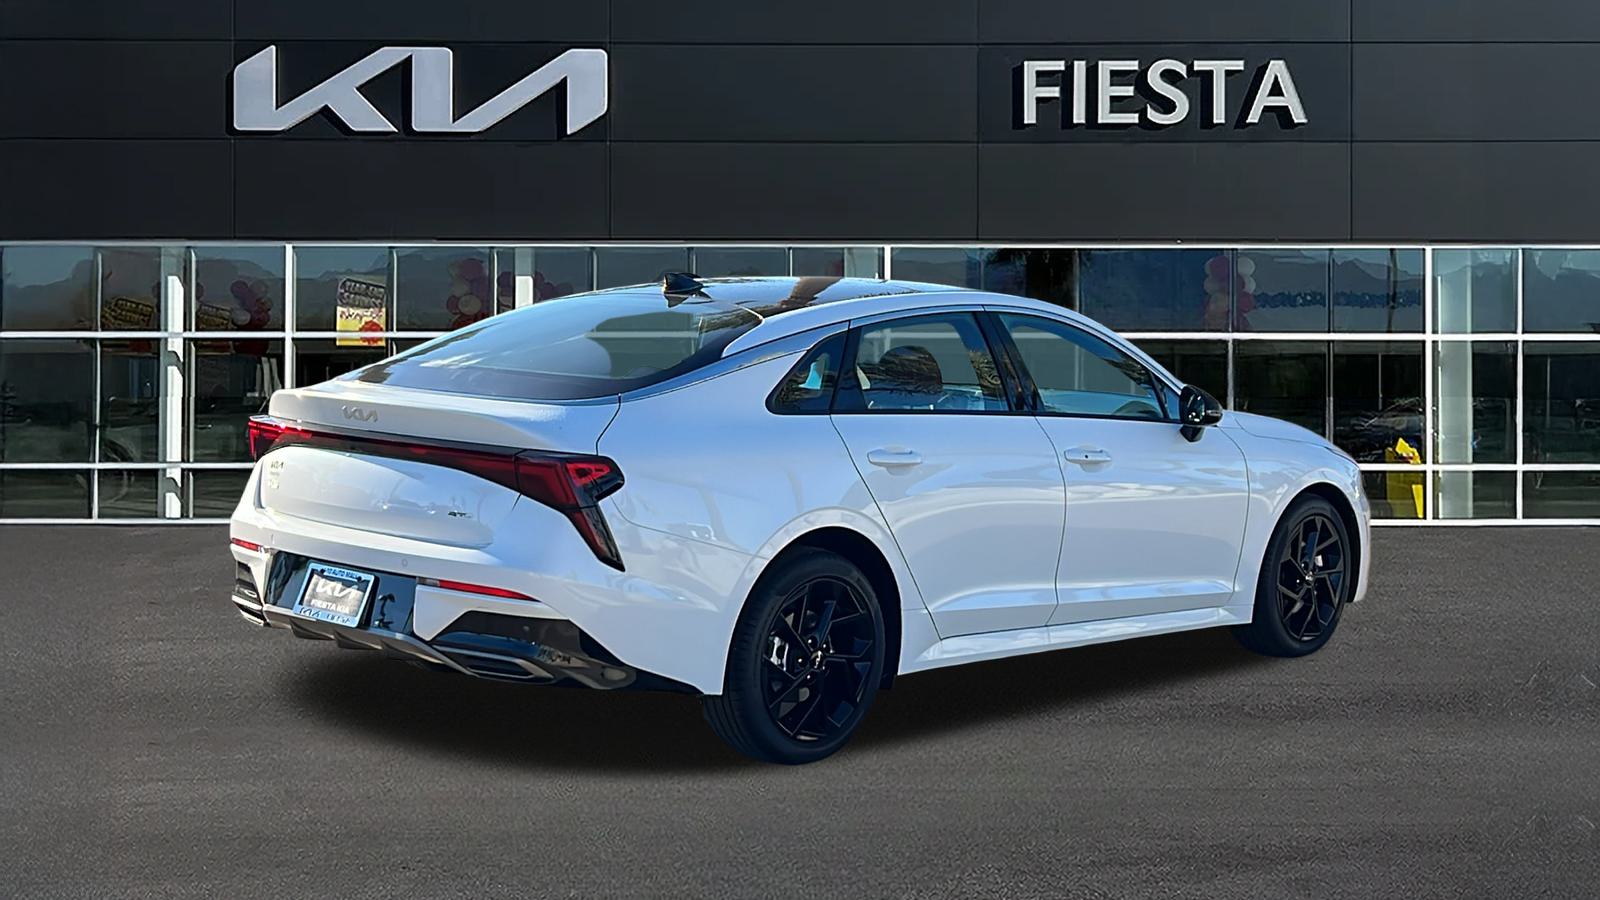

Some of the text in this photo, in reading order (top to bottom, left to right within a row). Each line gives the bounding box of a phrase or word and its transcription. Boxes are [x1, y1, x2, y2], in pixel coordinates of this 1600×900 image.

[233, 45, 608, 135] KIA
[1023, 59, 1308, 125] FIESTA
[316, 577, 359, 599] KIA
